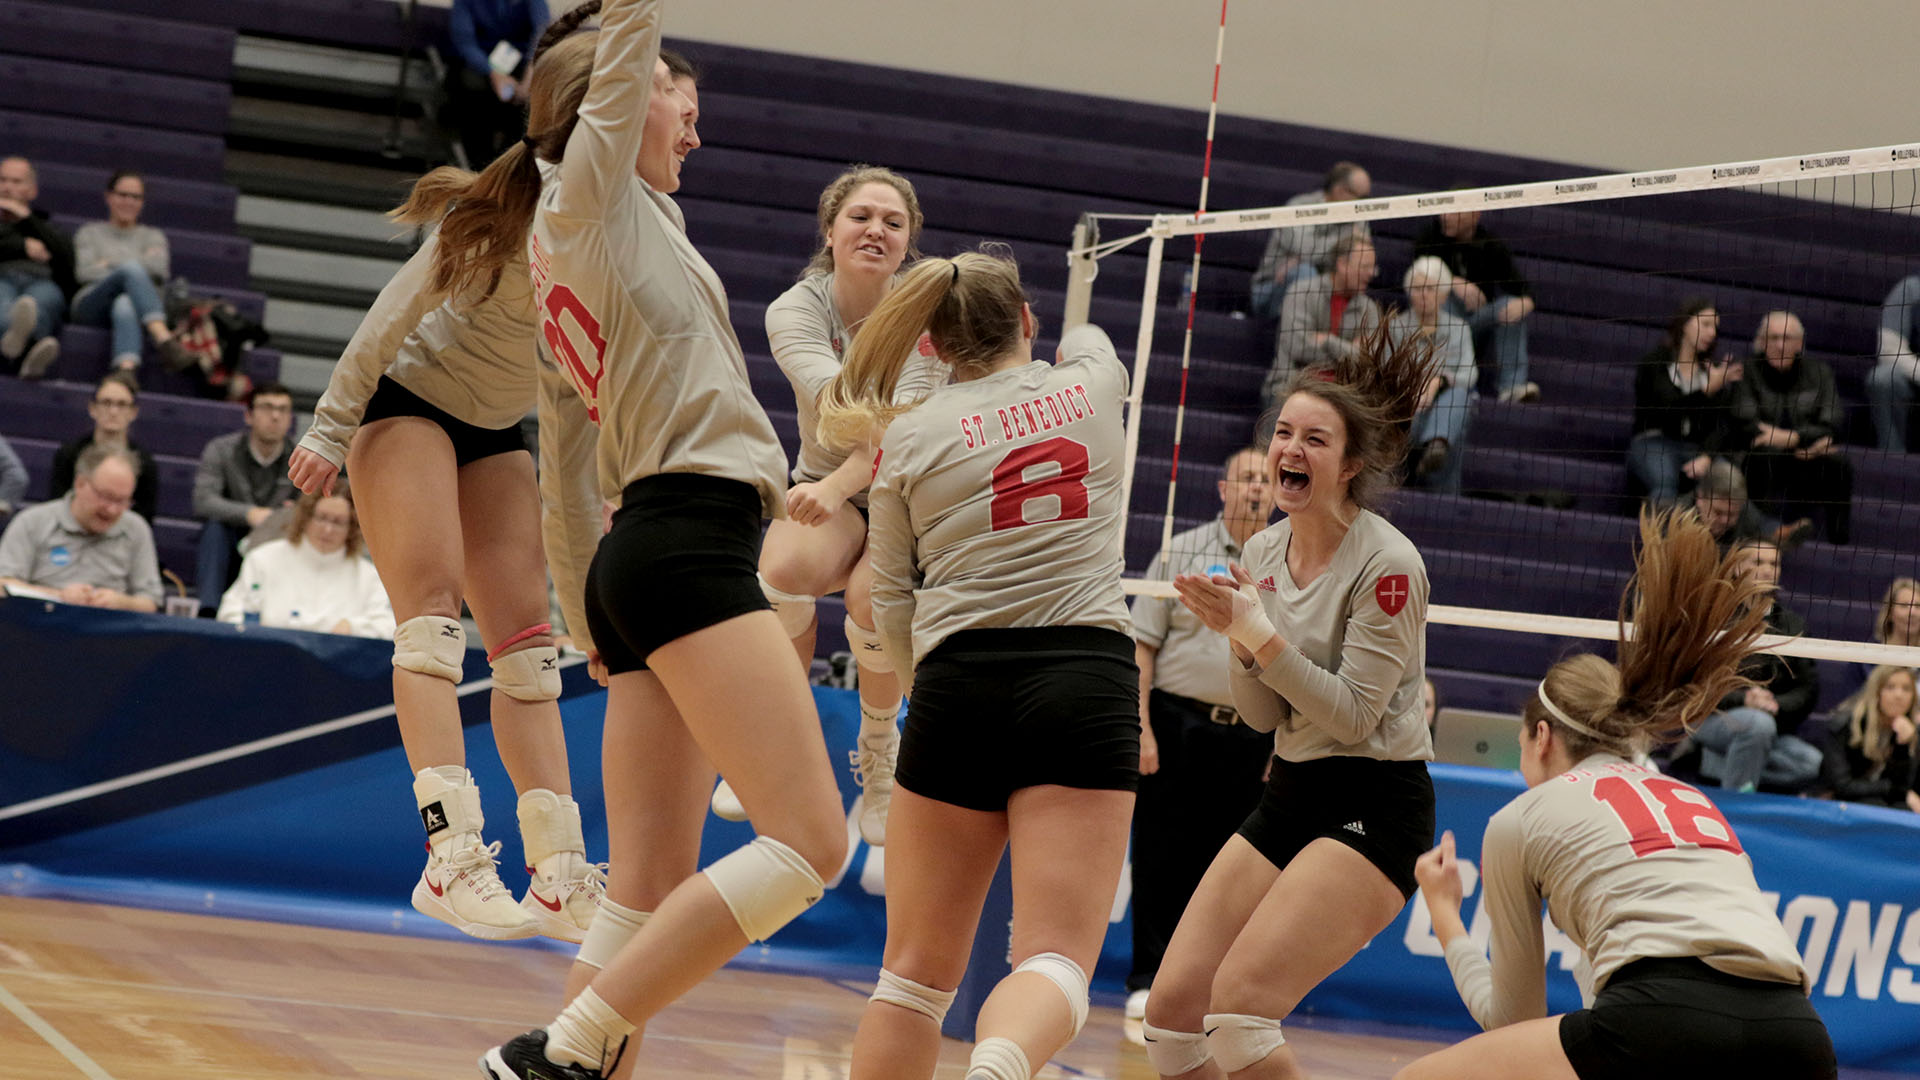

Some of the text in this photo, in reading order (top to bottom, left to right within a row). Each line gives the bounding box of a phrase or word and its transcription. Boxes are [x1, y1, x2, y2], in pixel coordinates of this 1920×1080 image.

[960, 384, 1095, 449] ST. BENEDICT
[990, 436, 1090, 532] 8
[1593, 775, 1745, 859] 18
